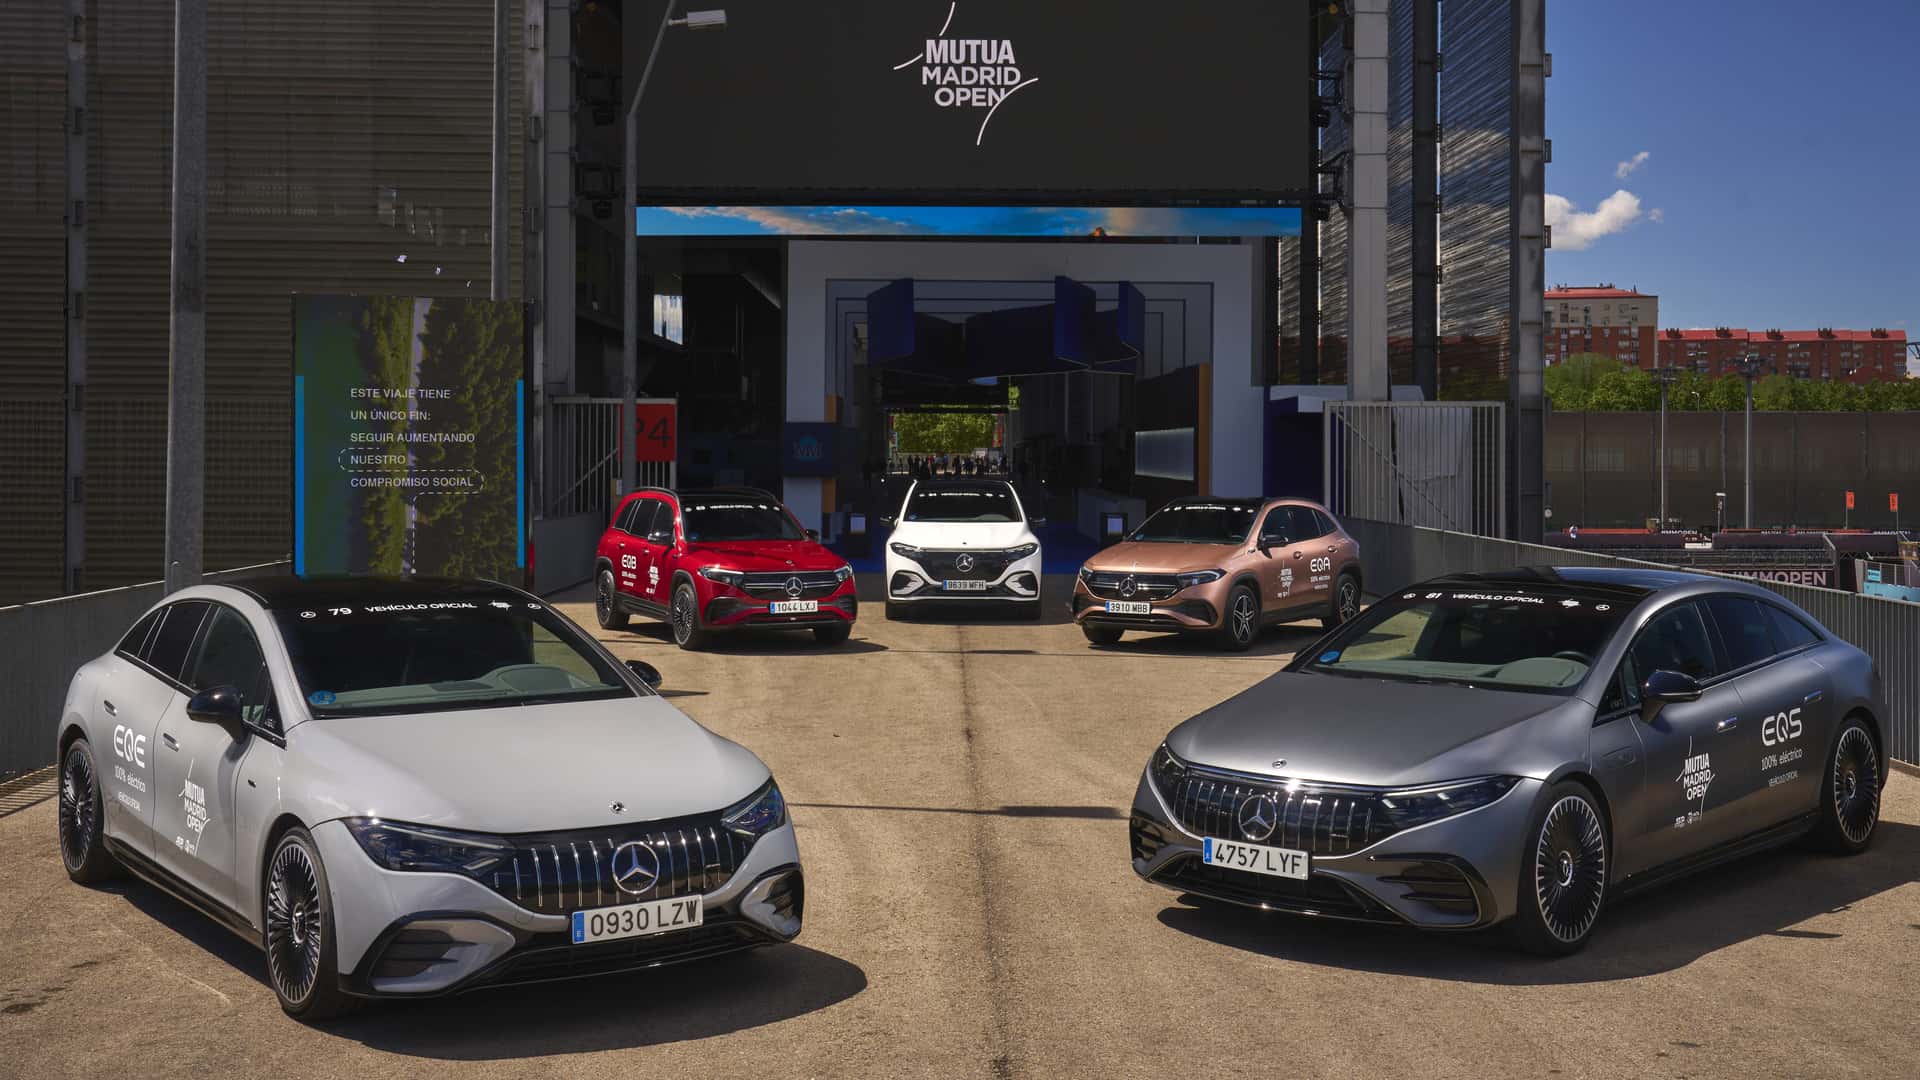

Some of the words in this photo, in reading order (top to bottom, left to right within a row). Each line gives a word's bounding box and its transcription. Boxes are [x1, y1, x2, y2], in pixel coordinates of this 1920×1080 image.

[926, 39, 1016, 64] MUTUA
[922, 66, 1021, 85] MADRID
[934, 87, 1006, 107] OPEN
[350, 388, 380, 398] ESTE
[383, 388, 416, 399] VIAJE
[419, 389, 451, 399] TIENE
[350, 410, 367, 420] UN
[370, 408, 406, 420] ÚNICO
[409, 411, 431, 420] FIN:
[350, 432, 394, 442] SEGUIR
[397, 432, 475, 442] AUMENTANDO
[350, 455, 406, 465] NUESTRO
[350, 477, 430, 487] COMPROMISO
[432, 477, 474, 487] SOCIAL
[621, 554, 636, 569] EQB
[1310, 556, 1330, 572] EQA
[328, 607, 352, 616] 79
[365, 602, 428, 613] VEHÍCULO
[429, 601, 478, 609] OFICIAL
[1110, 602, 1130, 611] 3910
[1504, 595, 1545, 604] OFICIAL
[1762, 707, 1802, 746] EQS
[114, 724, 146, 769] EQE
[1684, 752, 1710, 775] MUTUA
[1683, 769, 1711, 790] MADRID
[1686, 783, 1707, 800] OPEN
[184, 797, 207, 821] MADRID
[187, 814, 204, 833] OPEN
[1215, 843, 1260, 868] 4757
[1266, 850, 1302, 874] LYF
[590, 908, 649, 937] 0930
[657, 900, 698, 928] LZW
